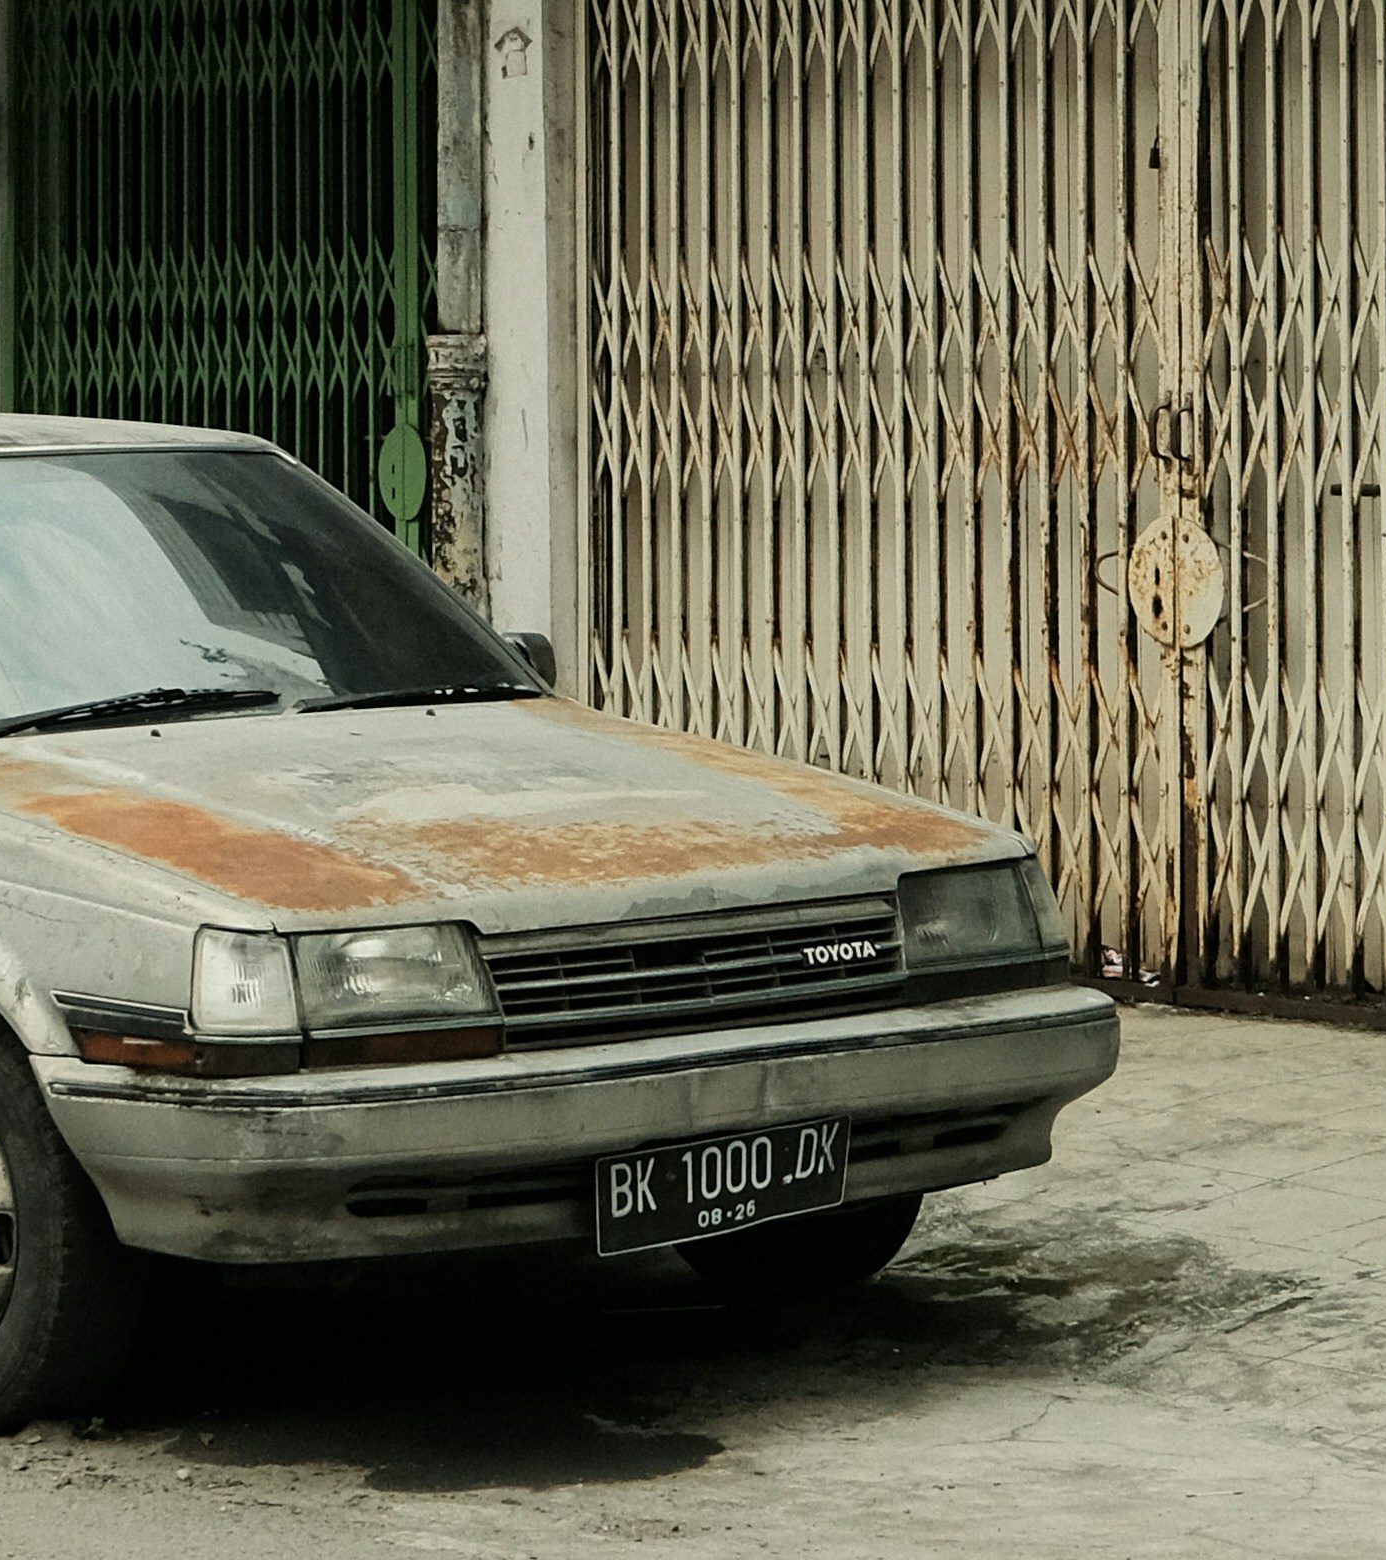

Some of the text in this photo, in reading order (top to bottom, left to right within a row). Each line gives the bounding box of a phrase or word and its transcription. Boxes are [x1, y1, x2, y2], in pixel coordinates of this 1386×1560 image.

[802, 940, 877, 965] TOYOTA
[610, 1122, 840, 1219] BK 1000 DK
